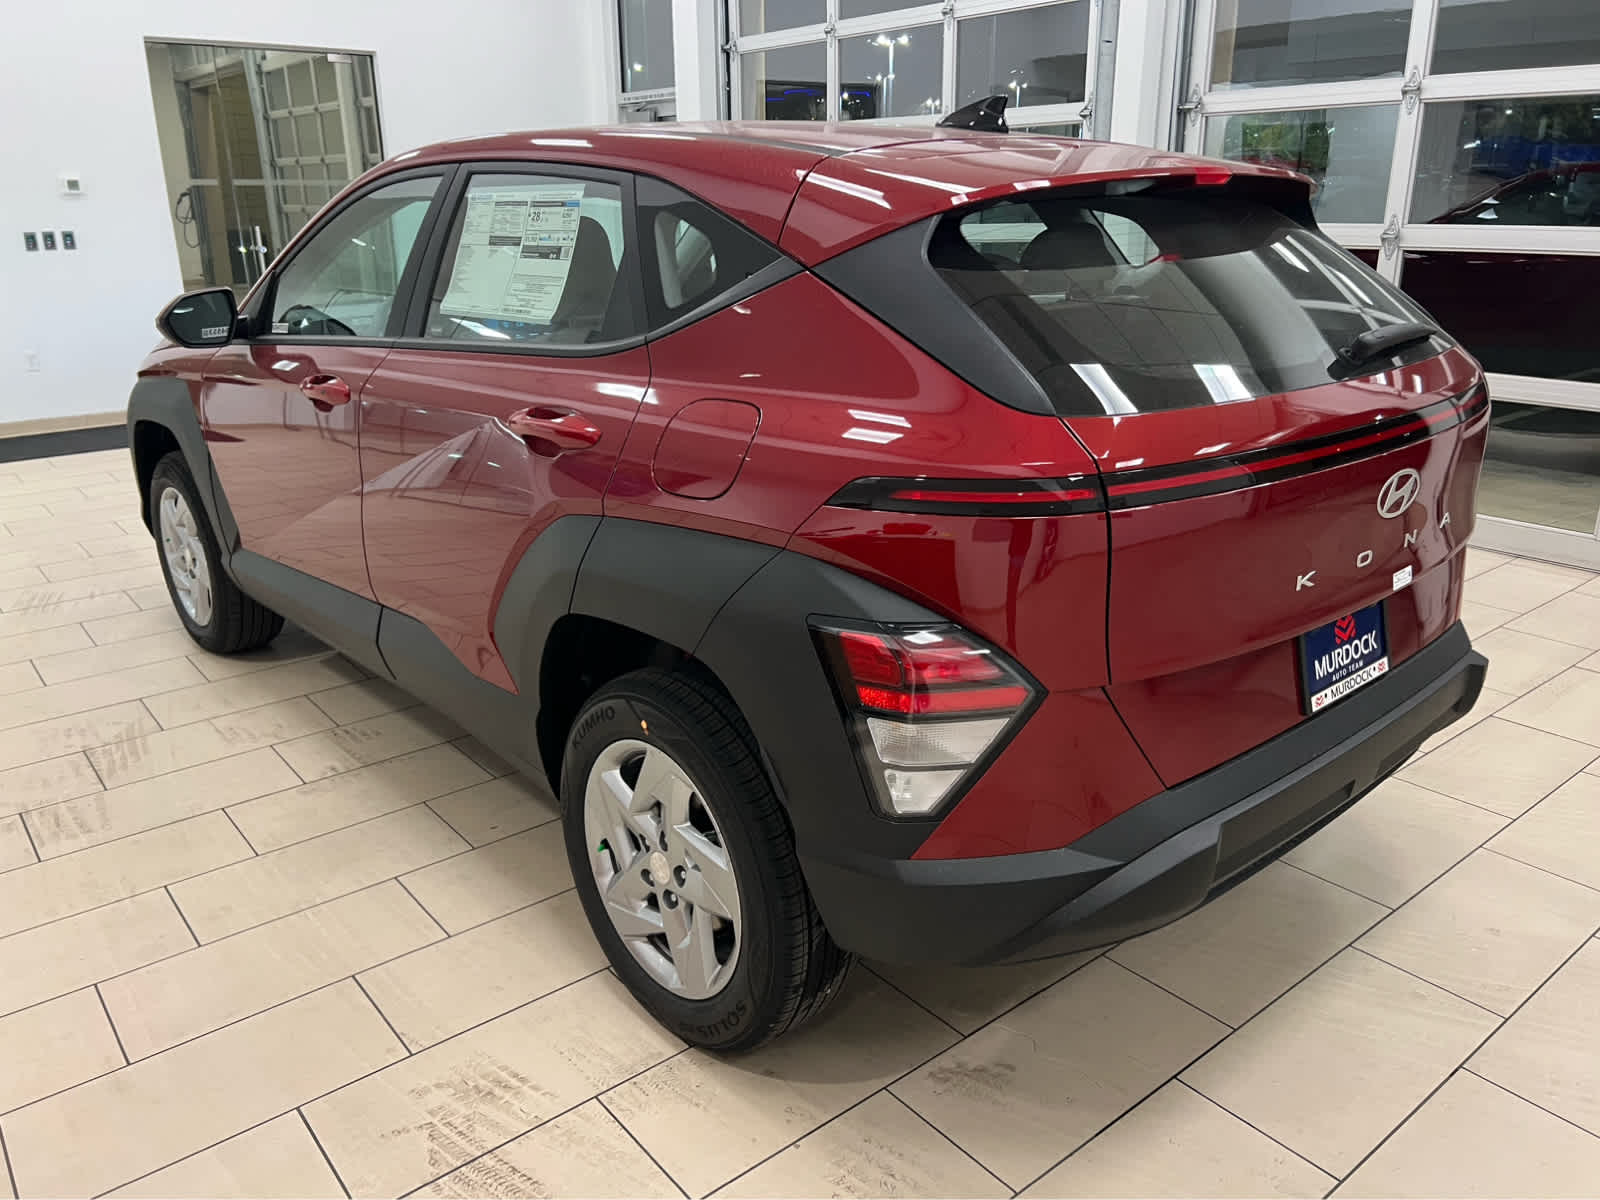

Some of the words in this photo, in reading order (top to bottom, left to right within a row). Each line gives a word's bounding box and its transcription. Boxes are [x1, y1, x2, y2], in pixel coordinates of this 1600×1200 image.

[1296, 512, 1451, 591] KONA
[1314, 630, 1377, 680] MURDOCK
[1332, 669, 1347, 682] AUTO
[1348, 660, 1364, 673] TEAM
[1330, 667, 1374, 699] MURDOCK
[571, 705, 616, 750] KUMHO
[696, 1000, 747, 1039] SOLUS
